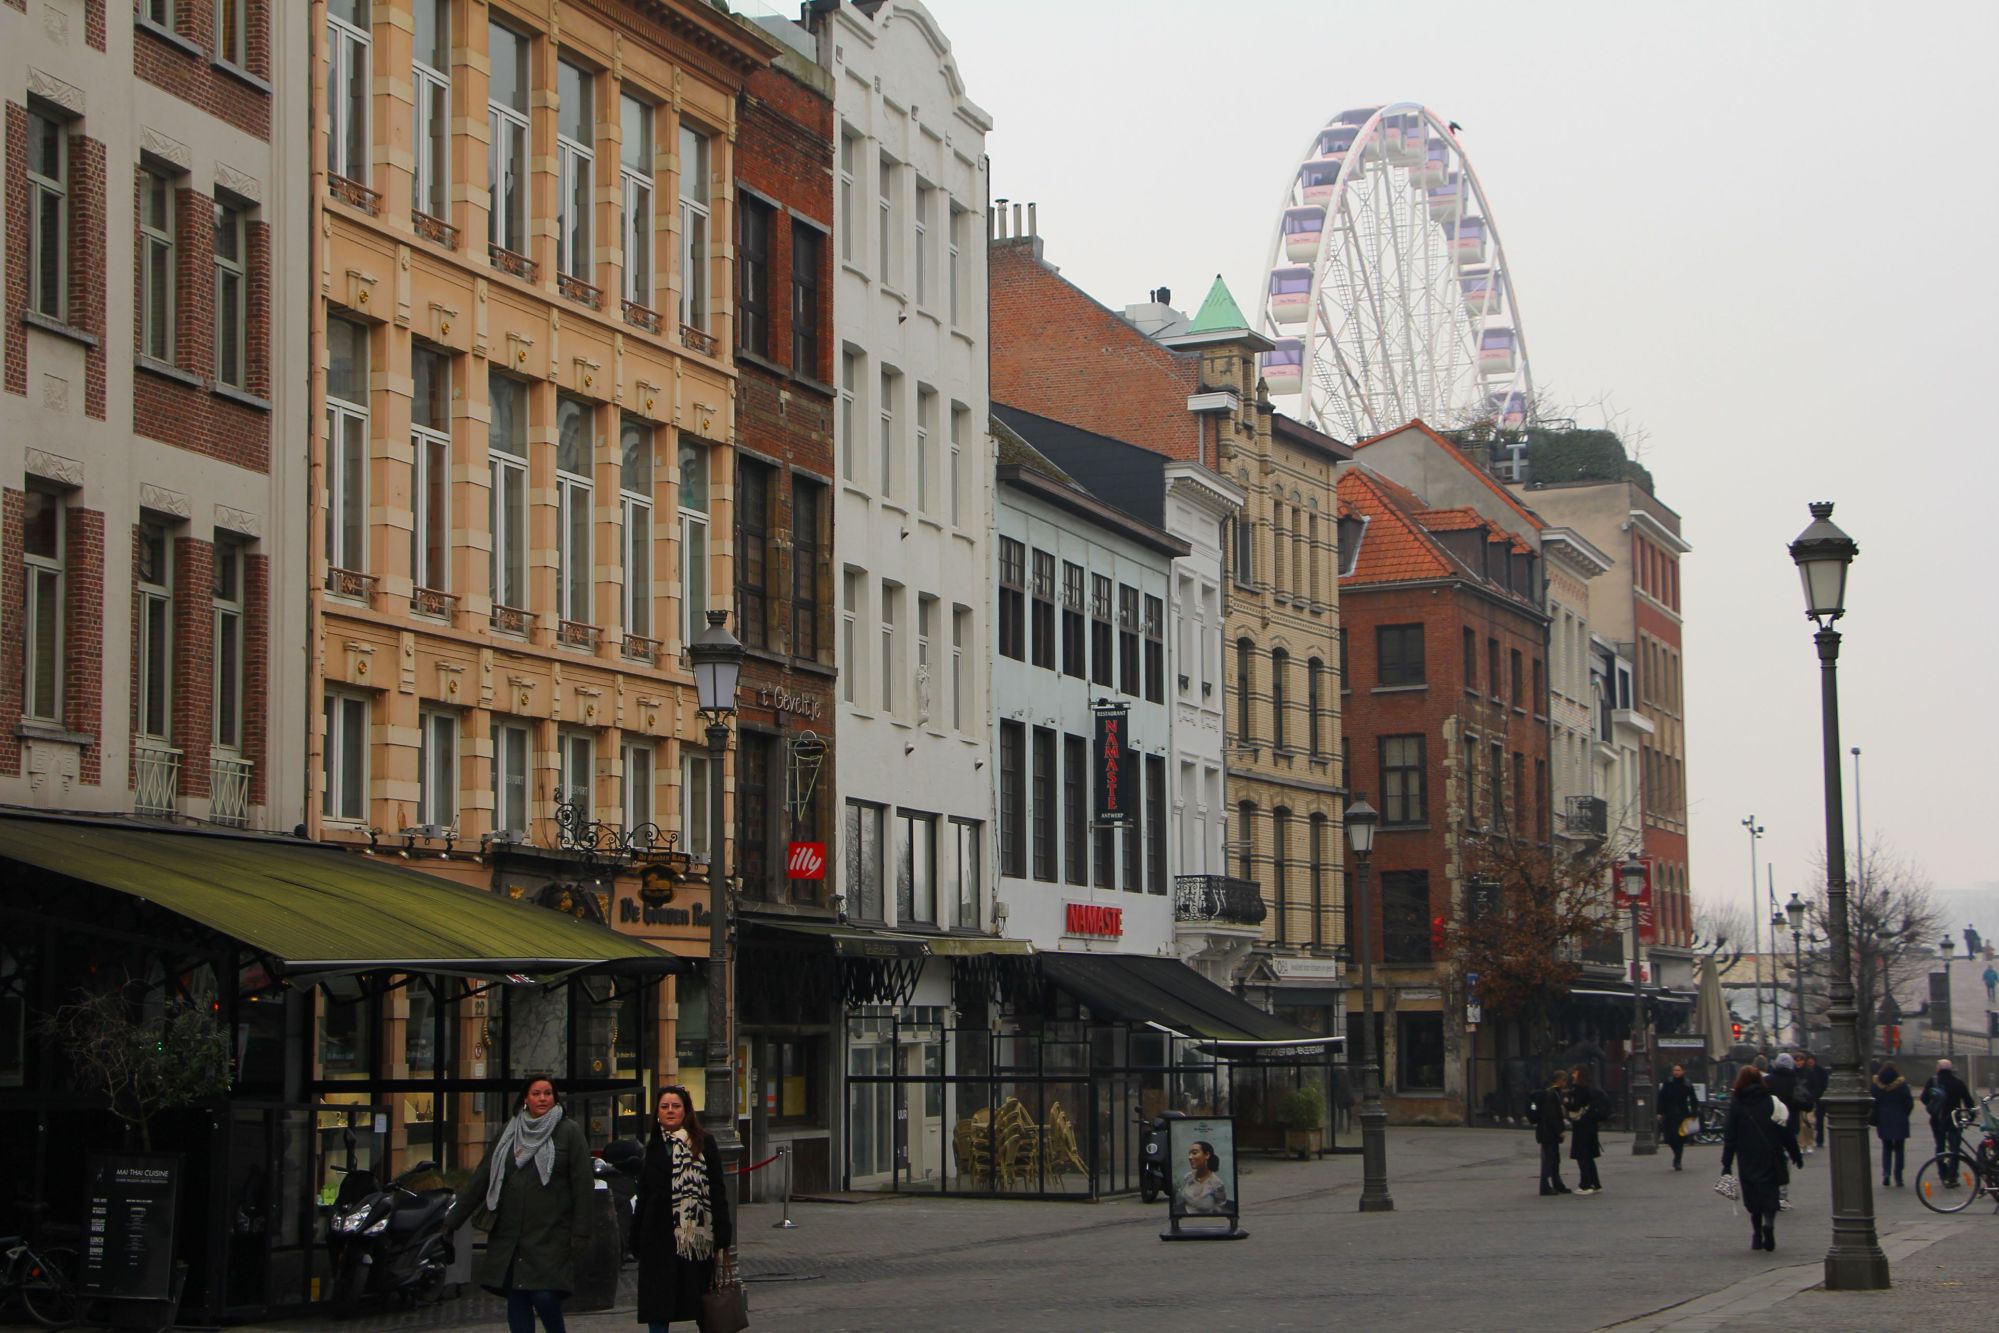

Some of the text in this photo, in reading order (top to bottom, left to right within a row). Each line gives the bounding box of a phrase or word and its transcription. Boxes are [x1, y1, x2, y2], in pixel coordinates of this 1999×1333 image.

[774, 685, 822, 721] Geveltje
[1104, 719, 1120, 810] NAMASTE
[789, 846, 822, 877] illy
[1066, 904, 1123, 936] NAMASTE
[144, 1169, 169, 1177] CUISINE
